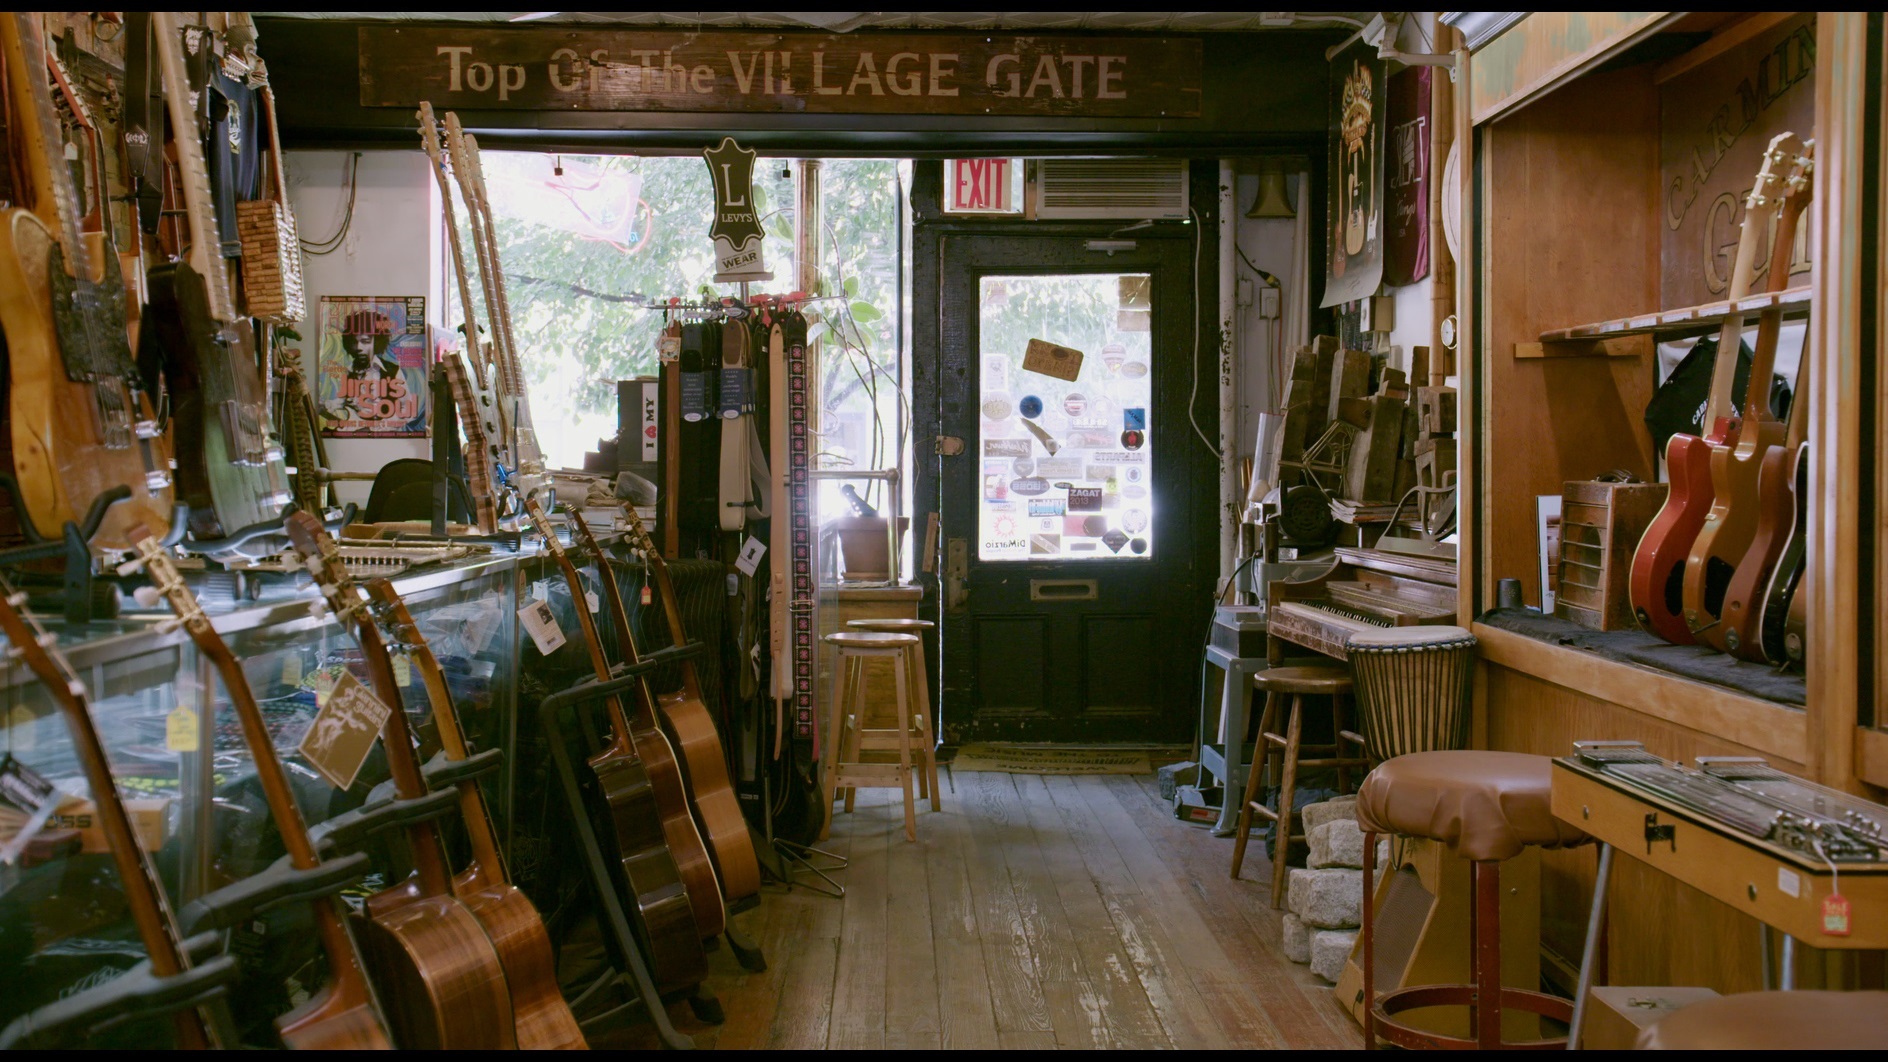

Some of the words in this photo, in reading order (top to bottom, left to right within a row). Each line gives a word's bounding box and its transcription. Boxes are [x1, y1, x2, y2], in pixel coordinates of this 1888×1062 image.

[437, 46, 526, 100] Top
[630, 50, 716, 94] The
[985, 53, 1128, 100] GATE
[721, 163, 745, 207] L
[955, 158, 1008, 210] EXIT
[721, 213, 753, 223] LEVY'S
[722, 252, 757, 270] WEAR
[337, 373, 407, 399] Jimi's
[357, 393, 419, 420] Soul
[646, 397, 655, 422] MY
[1069, 497, 1089, 505] 2013
[1070, 489, 1101, 498] ZAGAT
[44, 814, 92, 829] OSS
